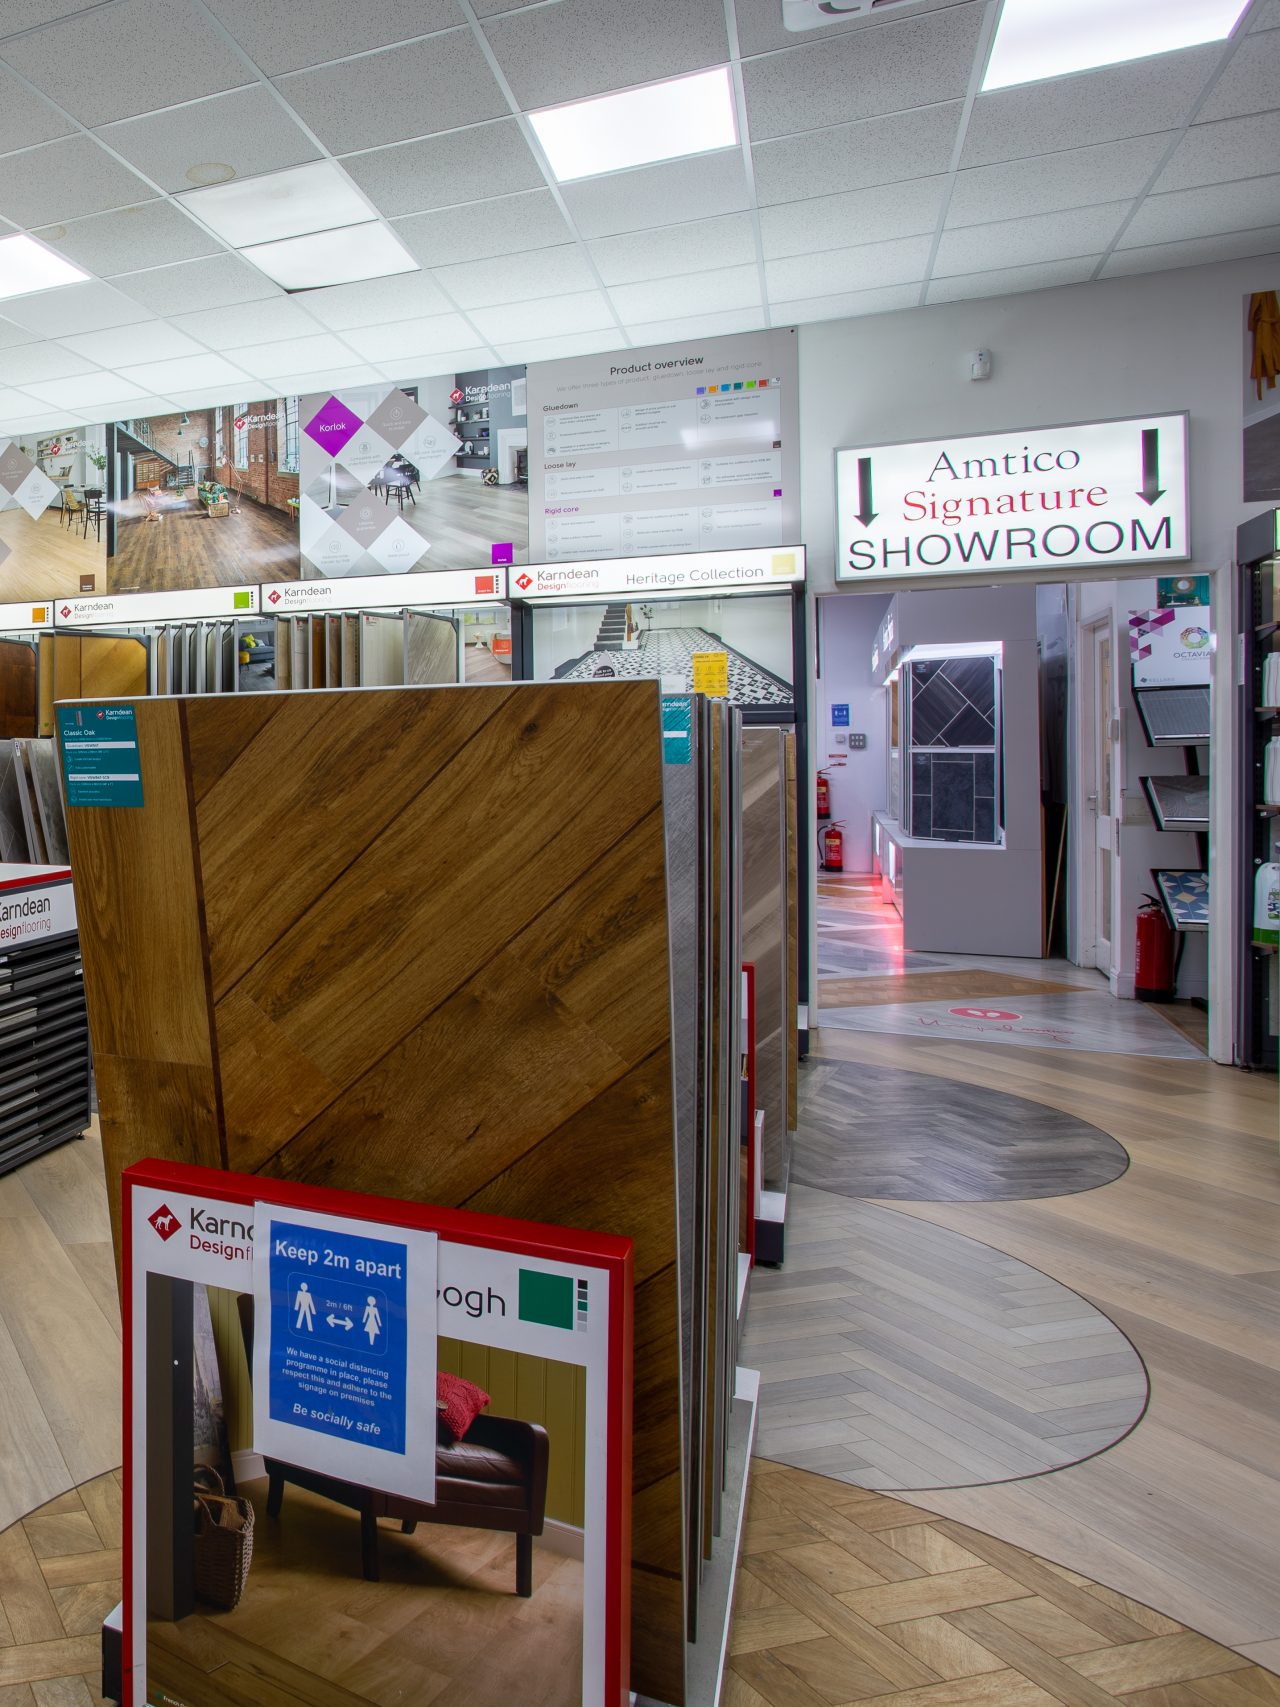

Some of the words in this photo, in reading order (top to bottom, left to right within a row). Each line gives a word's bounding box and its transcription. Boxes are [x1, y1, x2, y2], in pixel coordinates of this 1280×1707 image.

[610, 361, 652, 376] Product
[653, 355, 704, 371] overview
[543, 402, 579, 412] Gluedown
[319, 422, 347, 433] Korlok
[544, 462, 565, 470] Loose
[566, 461, 577, 469] lay
[925, 446, 1081, 484] Amtico
[544, 506, 562, 515] Rigid
[903, 485, 1109, 527] Signature
[848, 515, 1172, 571] SHOWROOM
[536, 568, 599, 582] Karndean
[626, 571, 685, 587] Heritage
[688, 566, 764, 582] Collection
[284, 587, 332, 597] Karndean
[74, 602, 114, 613] Karndean
[1173, 650, 1211, 658] OCTAVIA
[275, 1239, 319, 1266] Keep
[323, 1249, 350, 1269] 2m
[355, 1257, 402, 1280] apart
[326, 1300, 338, 1309] 2m
[342, 1303, 353, 1312] 6ft
[286, 1346, 298, 1356] We
[299, 1350, 318, 1361] have
[325, 1355, 348, 1368] social
[349, 1362, 389, 1380] distancing
[286, 1358, 328, 1375] programme
[329, 1367, 337, 1377] in
[363, 1376, 388, 1389] please
[282, 1367, 310, 1380] respect
[310, 1373, 325, 1384] this
[326, 1377, 341, 1387] and
[342, 1382, 369, 1395] adhere
[369, 1388, 378, 1397] to
[379, 1390, 392, 1400] the
[298, 1381, 327, 1395] signage
[328, 1389, 339, 1397] on
[340, 1392, 376, 1407] premises
[293, 1403, 308, 1416] Be
[310, 1409, 354, 1430] socially
[356, 1421, 381, 1435] safe
